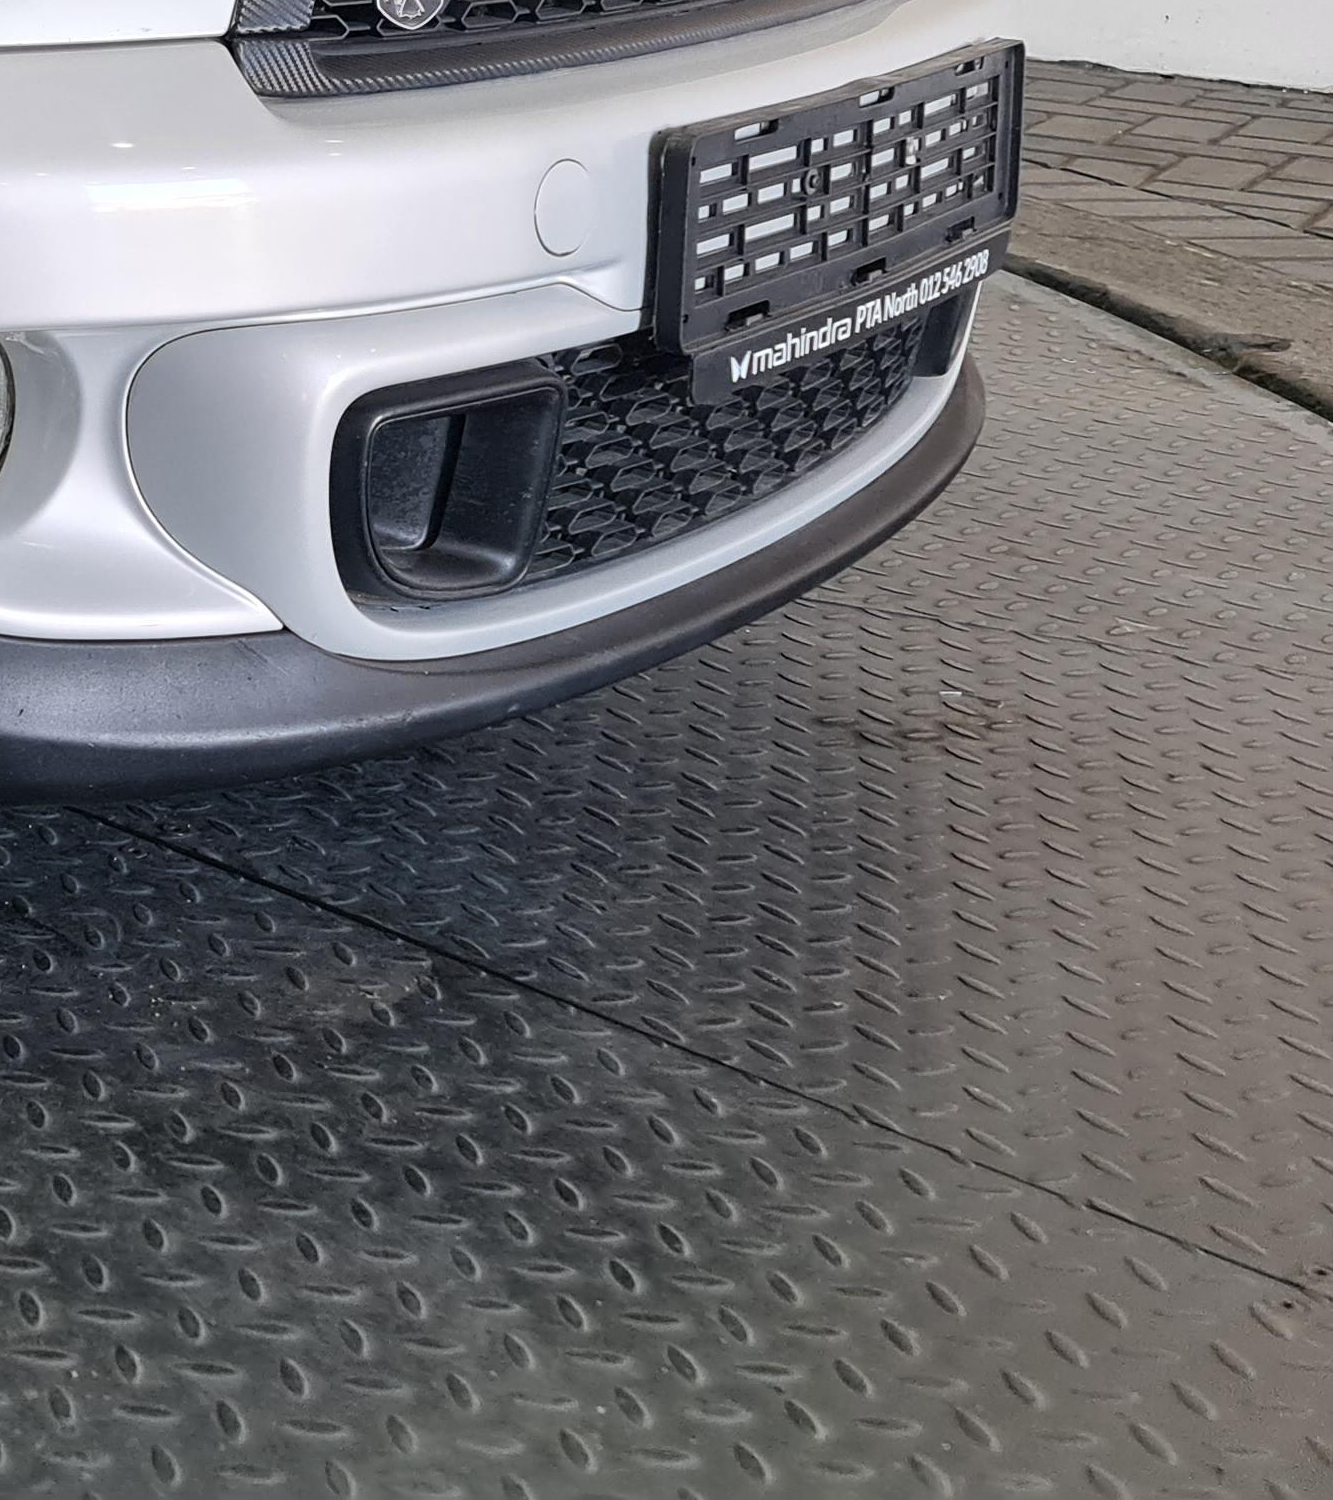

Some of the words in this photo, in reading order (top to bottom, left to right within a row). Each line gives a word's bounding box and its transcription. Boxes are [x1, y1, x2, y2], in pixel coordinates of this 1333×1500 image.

[751, 317, 851, 375] mahindra
[854, 299, 883, 334] PTA
[883, 283, 919, 322] North
[919, 271, 941, 304] 012
[941, 261, 963, 294] 546
